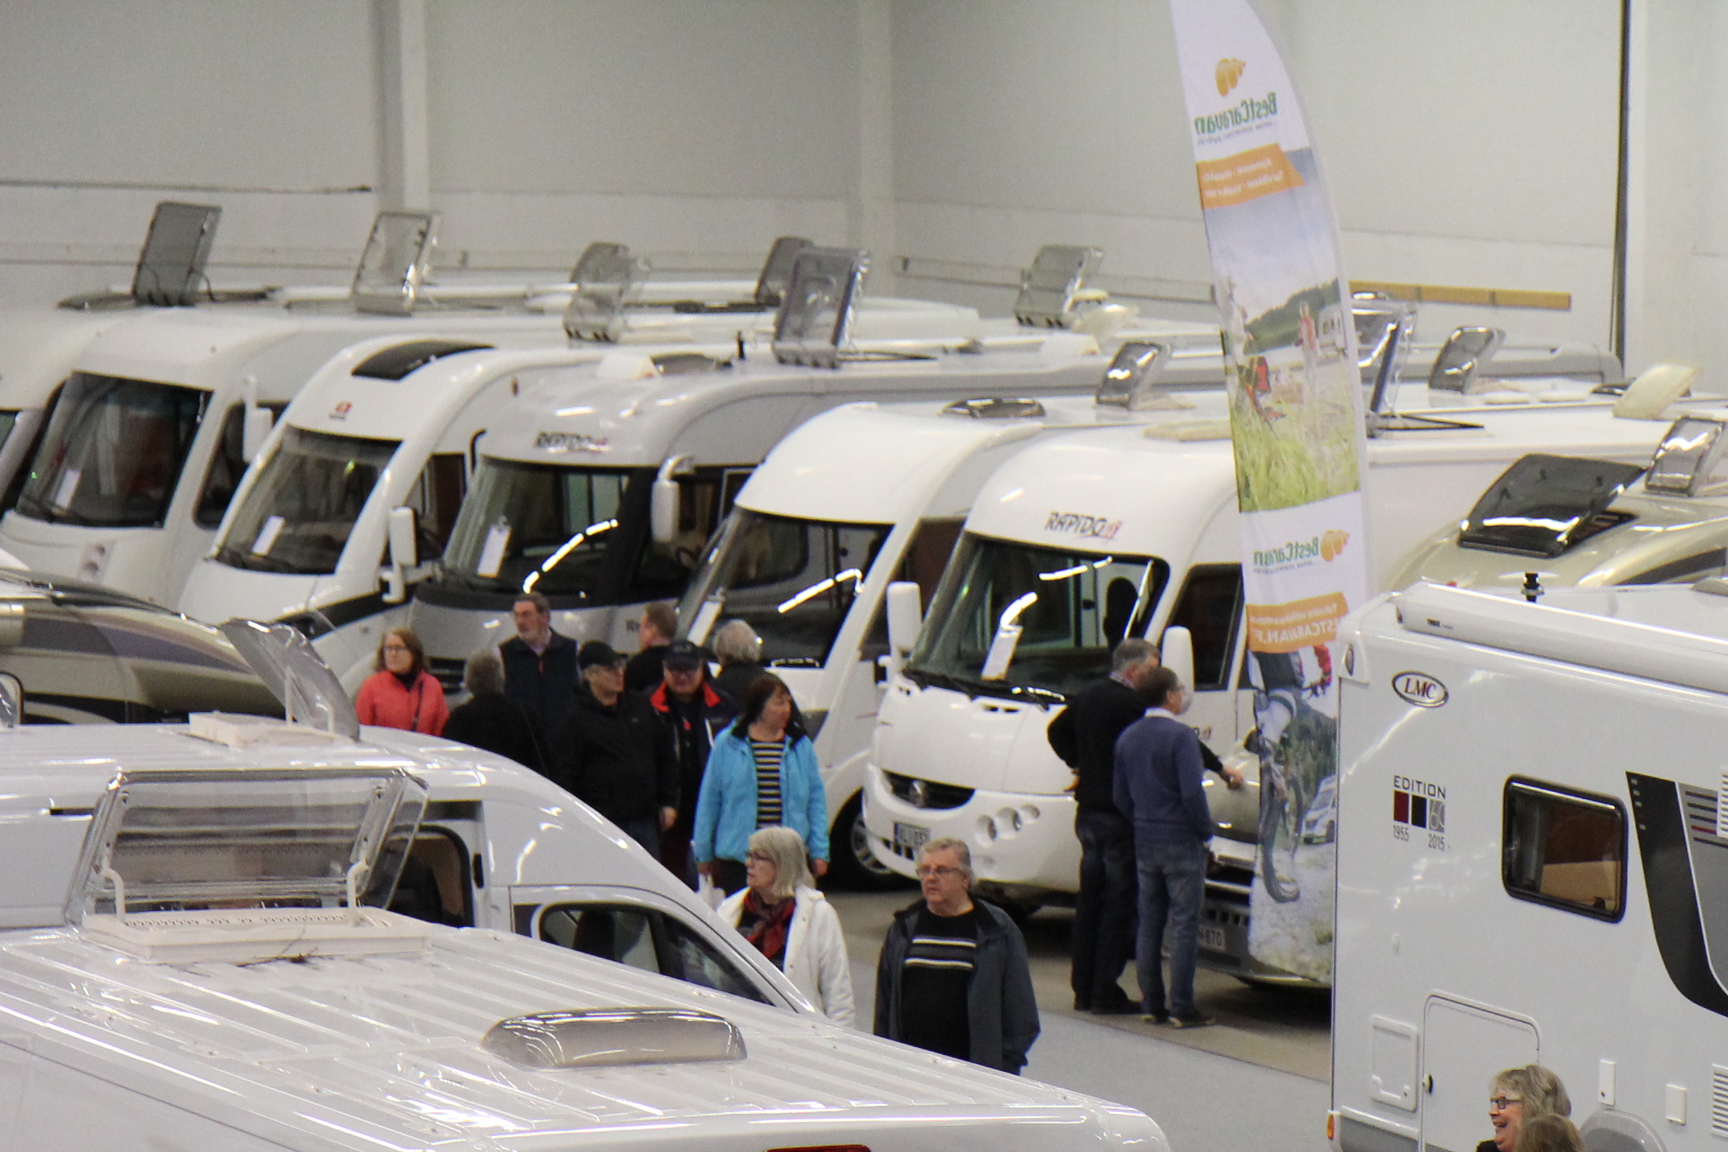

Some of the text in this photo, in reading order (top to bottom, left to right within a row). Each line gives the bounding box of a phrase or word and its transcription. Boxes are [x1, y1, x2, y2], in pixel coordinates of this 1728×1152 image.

[1404, 677, 1437, 699] LMC
[1393, 775, 1446, 799] EDITION
[1393, 825, 1410, 842] 1955
[1428, 833, 1446, 851] 2015
